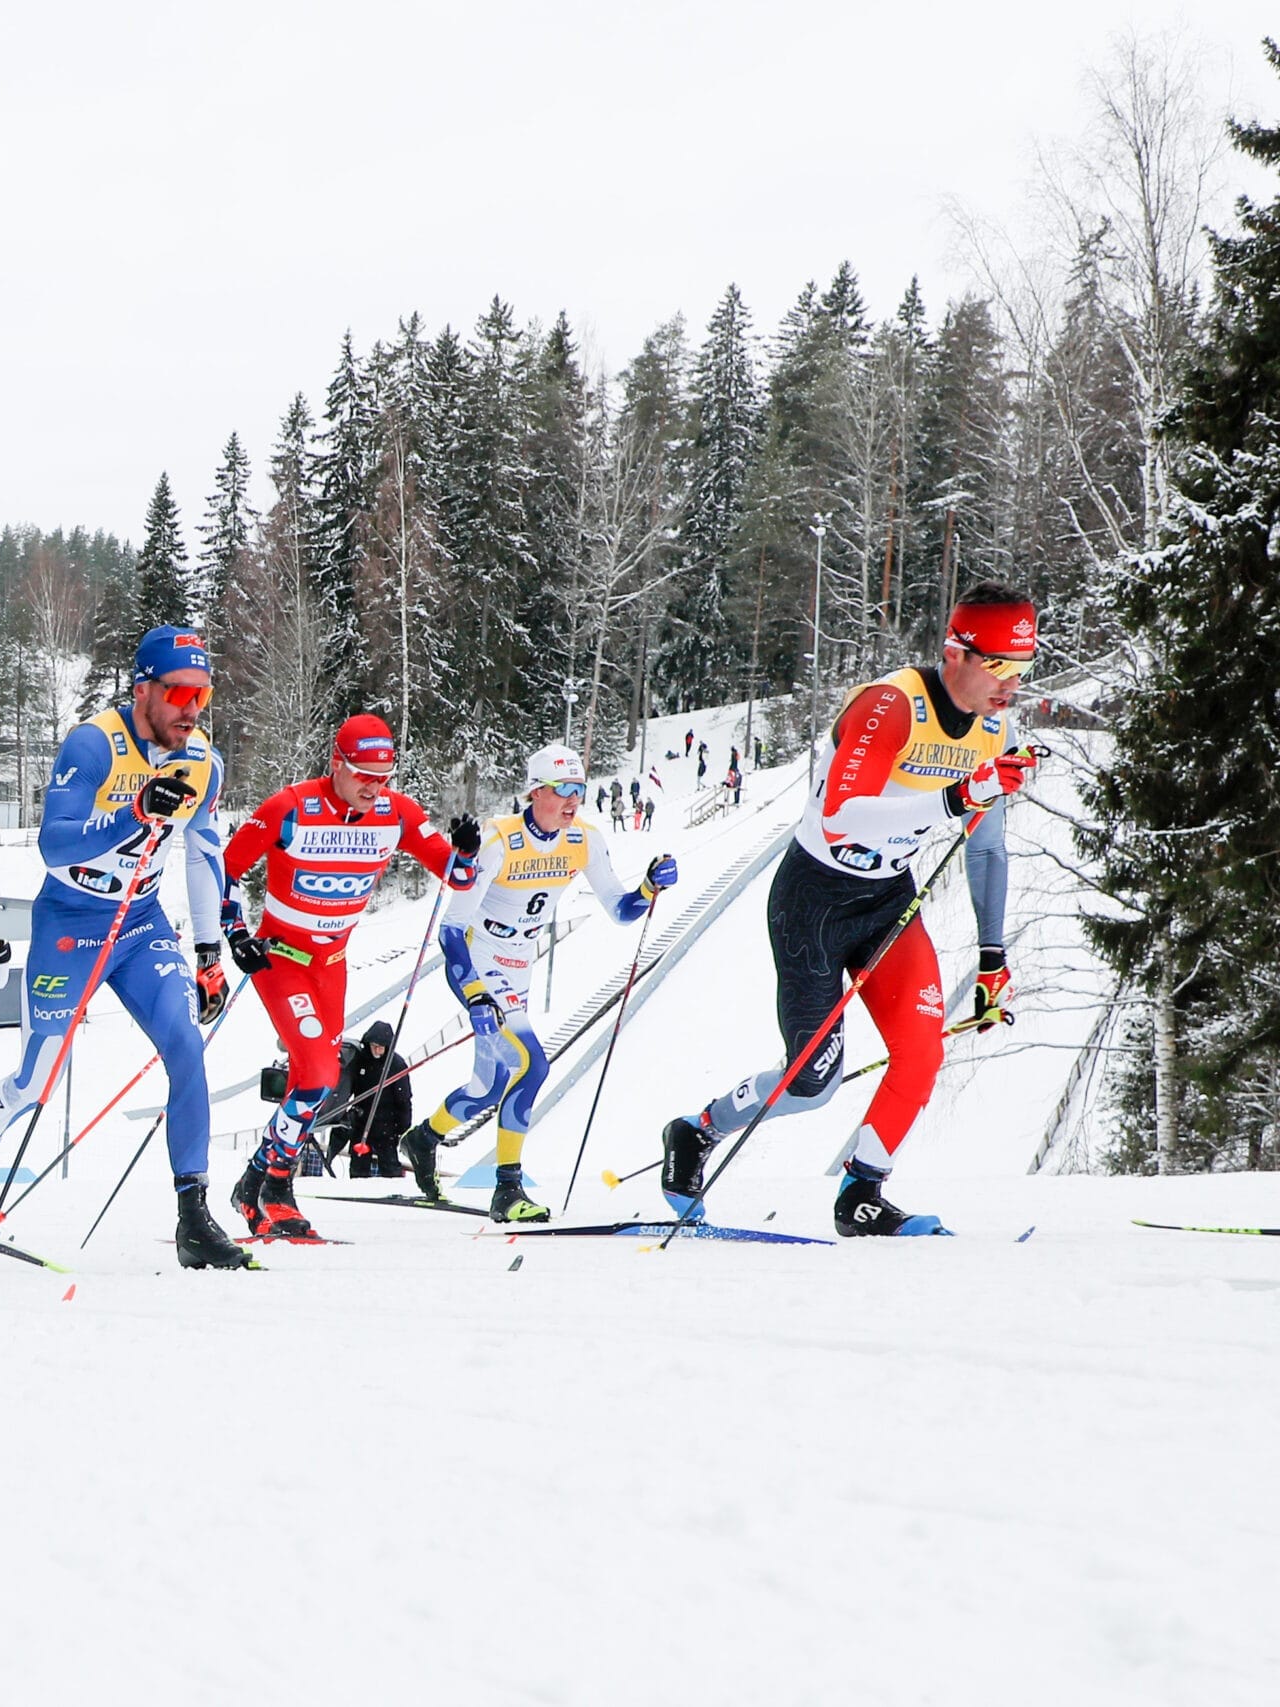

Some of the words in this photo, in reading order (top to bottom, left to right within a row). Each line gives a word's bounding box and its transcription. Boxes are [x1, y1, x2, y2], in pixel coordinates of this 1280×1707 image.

[839, 692, 896, 791] PEMBROKE
[908, 742, 923, 763] LE
[925, 743, 978, 769] GRUYÈRE
[112, 774, 127, 791] LE
[82, 809, 116, 835] FIN
[116, 823, 174, 857] 27
[303, 831, 319, 846] LE
[321, 828, 378, 847] GRUYÈRE
[301, 847, 377, 855] SWITZERLAND
[509, 861, 521, 874] LE
[523, 855, 569, 873] GRUYÈRE
[298, 874, 376, 896] coop
[526, 892, 548, 915] 6
[317, 919, 345, 929] Lahti
[32, 975, 69, 992] FF
[279, 1120, 289, 1134] 2
